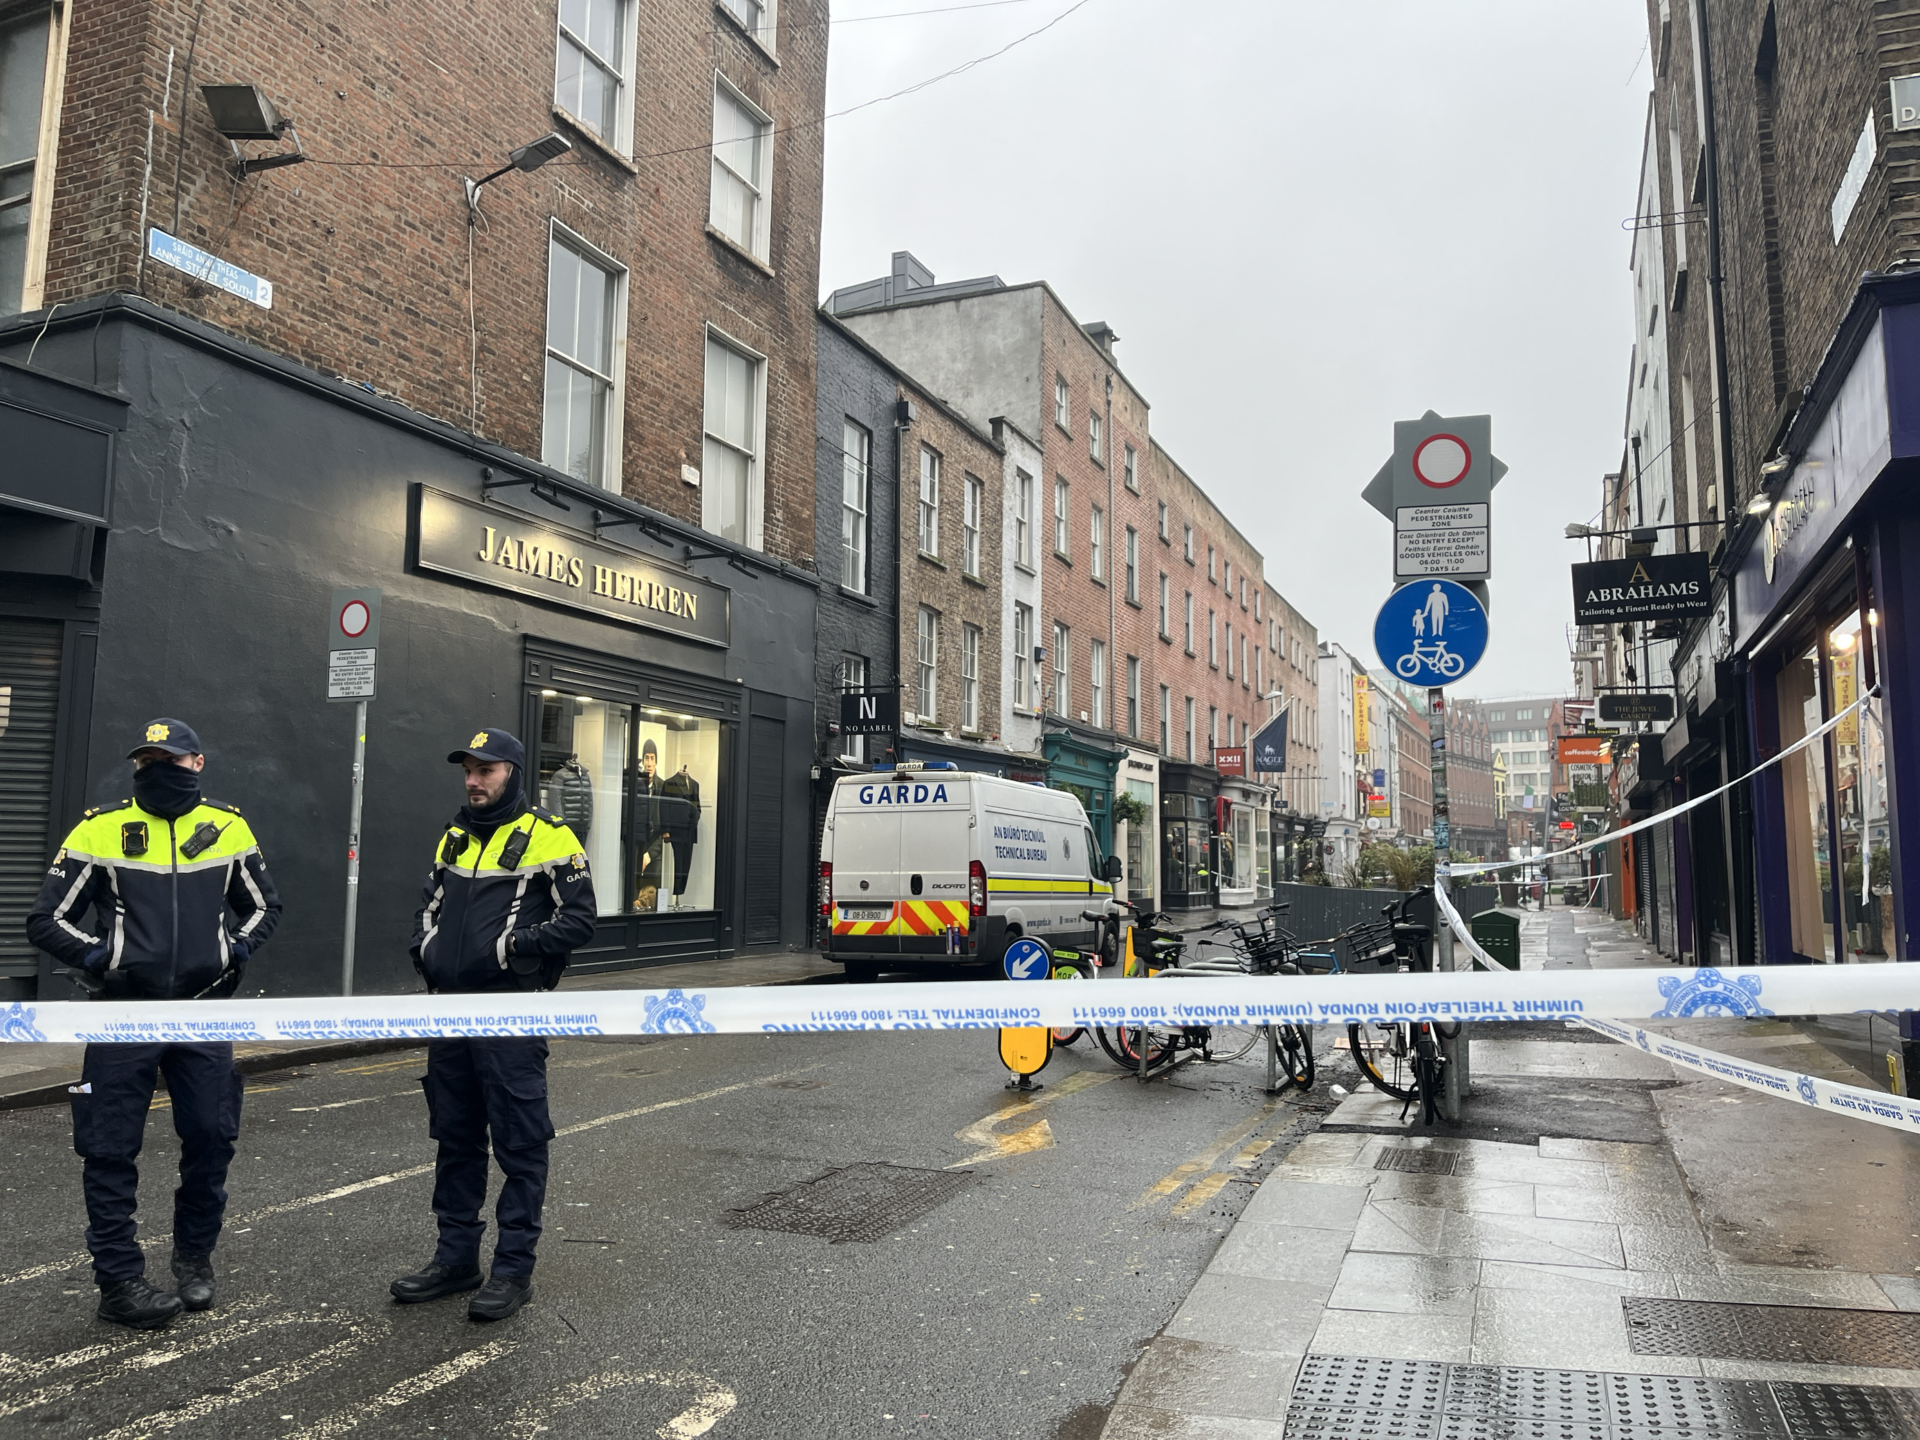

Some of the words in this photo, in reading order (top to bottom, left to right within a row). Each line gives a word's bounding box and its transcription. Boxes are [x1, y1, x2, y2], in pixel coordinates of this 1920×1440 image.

[155, 247, 181, 266] ANNE
[185, 261, 219, 283] STREET
[223, 278, 253, 298] SOUTH
[217, 262, 239, 280] THEAS
[260, 286, 269, 301] 2
[1410, 513, 1473, 522] PEDESTRIANISED
[478, 525, 584, 588] JAMES
[592, 564, 698, 621] HERREN
[1629, 561, 1653, 583] A
[1585, 581, 1700, 603] ABRAHAMS
[1579, 608, 1615, 616] Tailoring
[1625, 604, 1649, 613] Finest
[1650, 603, 1675, 612] Ready
[859, 696, 876, 720] N
[1631, 705, 1660, 714] JEWEL
[859, 784, 948, 804] GARDA
[994, 826, 1003, 839] AN
[995, 846, 1026, 860] TECHNICAL
[1026, 849, 1047, 861] BUREAU
[1073, 1006, 1126, 1018] 666111
[1131, 1006, 1167, 1017] 1800
[1173, 1003, 1240, 1017] RUNDA):
[1245, 1001, 1312, 1017] (UIMHIR
[1317, 1003, 1379, 1015] RUNDA
[1385, 1001, 1507, 1015] THEILEAFOIN
[1512, 999, 1584, 1012] UIMHIR
[554, 1014, 598, 1025] UIMHIR
[811, 1010, 857, 1021] 666111
[861, 1010, 893, 1020] 1800
[898, 1009, 929, 1020] TEL:
[932, 1007, 1041, 1020] CONFIDENTIAL
[104, 1022, 136, 1032] 666111
[138, 1022, 160, 1031] 1800
[162, 1022, 183, 1031] TEL:
[185, 1021, 256, 1031] CONFIDENTIAL
[276, 1020, 311, 1030] 666111
[314, 1020, 338, 1029] 1800
[341, 1016, 384, 1028] RUNDA):
[387, 1015, 430, 1028] (UIMHIR
[433, 1016, 471, 1027] RUNDA
[475, 1015, 551, 1026] THEILEAFOIN
[1733, 1070, 1744, 1080] AR
[1744, 1073, 1764, 1086] COSC
[1764, 1079, 1790, 1092] GARDA
[1829, 1095, 1857, 1110] ENTRY
[1857, 1102, 1871, 1114] NO
[1872, 1105, 1904, 1121] GARDA
